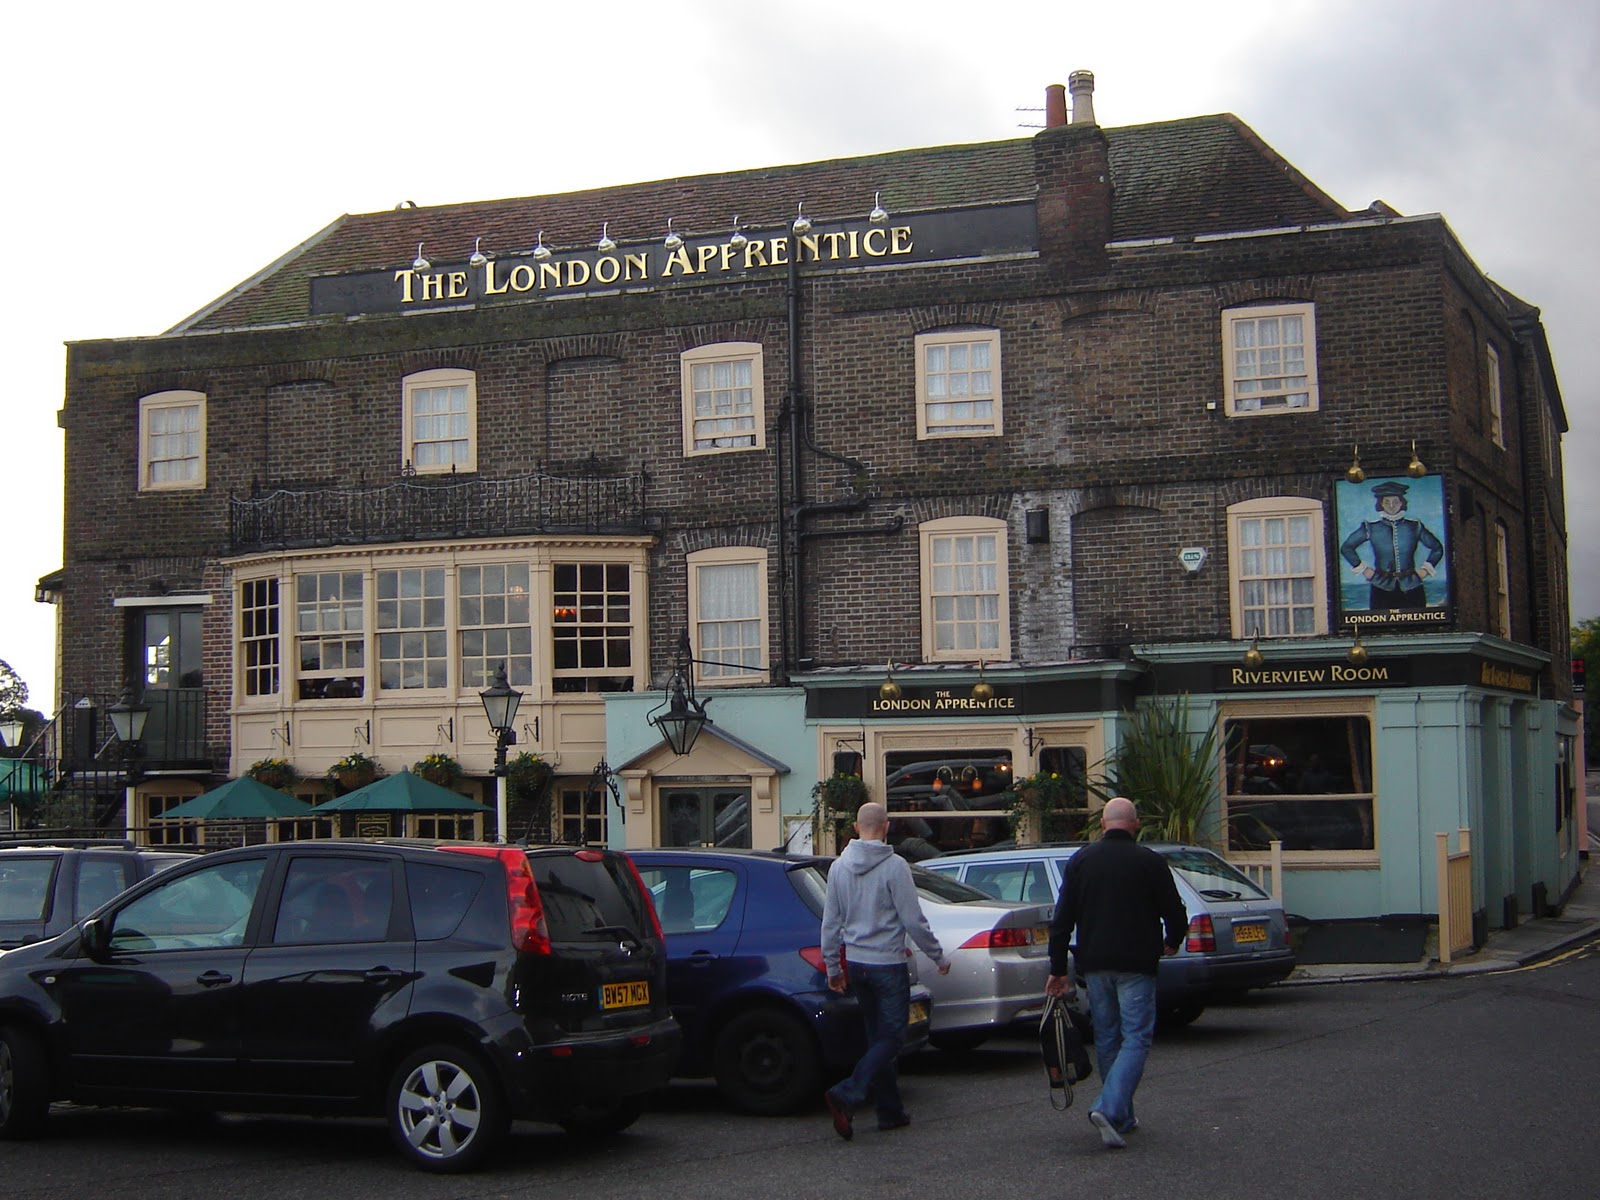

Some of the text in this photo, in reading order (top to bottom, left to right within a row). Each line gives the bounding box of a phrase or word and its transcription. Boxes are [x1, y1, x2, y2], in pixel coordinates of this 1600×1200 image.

[395, 225, 914, 302] THE LONDON APPRENTICE
[1345, 612, 1446, 624] LONDON APPRENTICE
[1232, 665, 1388, 684] RIVERVIEW ROOM
[873, 698, 1015, 711] LONDON APPRENTICE
